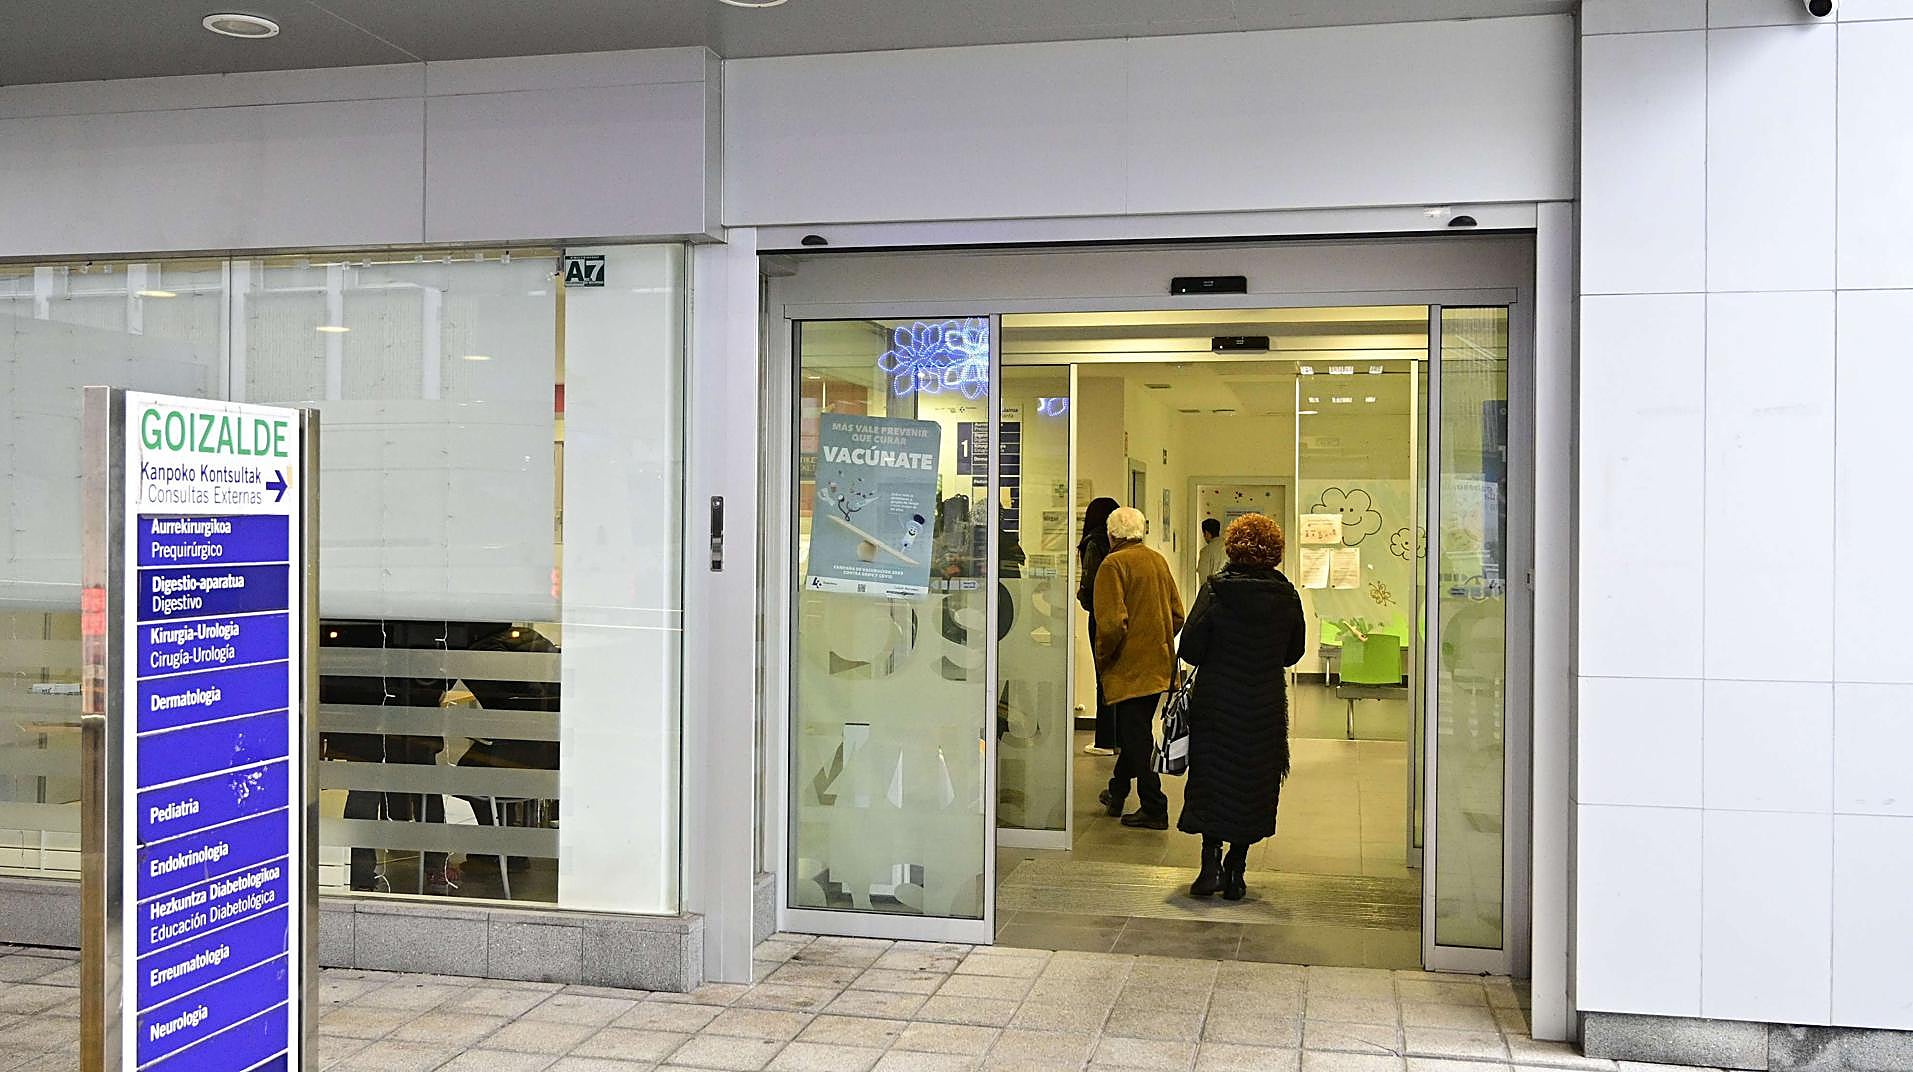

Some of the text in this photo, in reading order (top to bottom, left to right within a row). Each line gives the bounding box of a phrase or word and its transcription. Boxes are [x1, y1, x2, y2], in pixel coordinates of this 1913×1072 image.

[141, 408, 288, 458] GOIZALDE
[851, 433, 907, 446] QUE CURAR
[855, 424, 880, 435] VALE
[881, 426, 929, 438] PREVENIR
[823, 445, 934, 470] VACÚNATE
[961, 439, 968, 458] 1
[141, 461, 262, 486] Kanpoko Kontsultak
[148, 483, 263, 505] Consultas Externas
[151, 517, 232, 538] Aurrekirurgikoa
[151, 541, 223, 561] Prequirúrgico
[152, 573, 245, 596] Digestio-aparatua
[152, 593, 203, 615] Digestivo
[150, 620, 240, 645] Kirurgia-Urologia
[150, 643, 235, 669] Cirugía-Urología
[150, 685, 222, 712] Dermatologia
[150, 798, 200, 825] Pediatria
[150, 841, 229, 878] Endokrinologia
[150, 866, 281, 921] Hezkuntza Diabetologikoa
[150, 889, 276, 944] Educación Diabetológica
[150, 944, 231, 988] Erreumatologia
[150, 1004, 209, 1042] Neurologia
